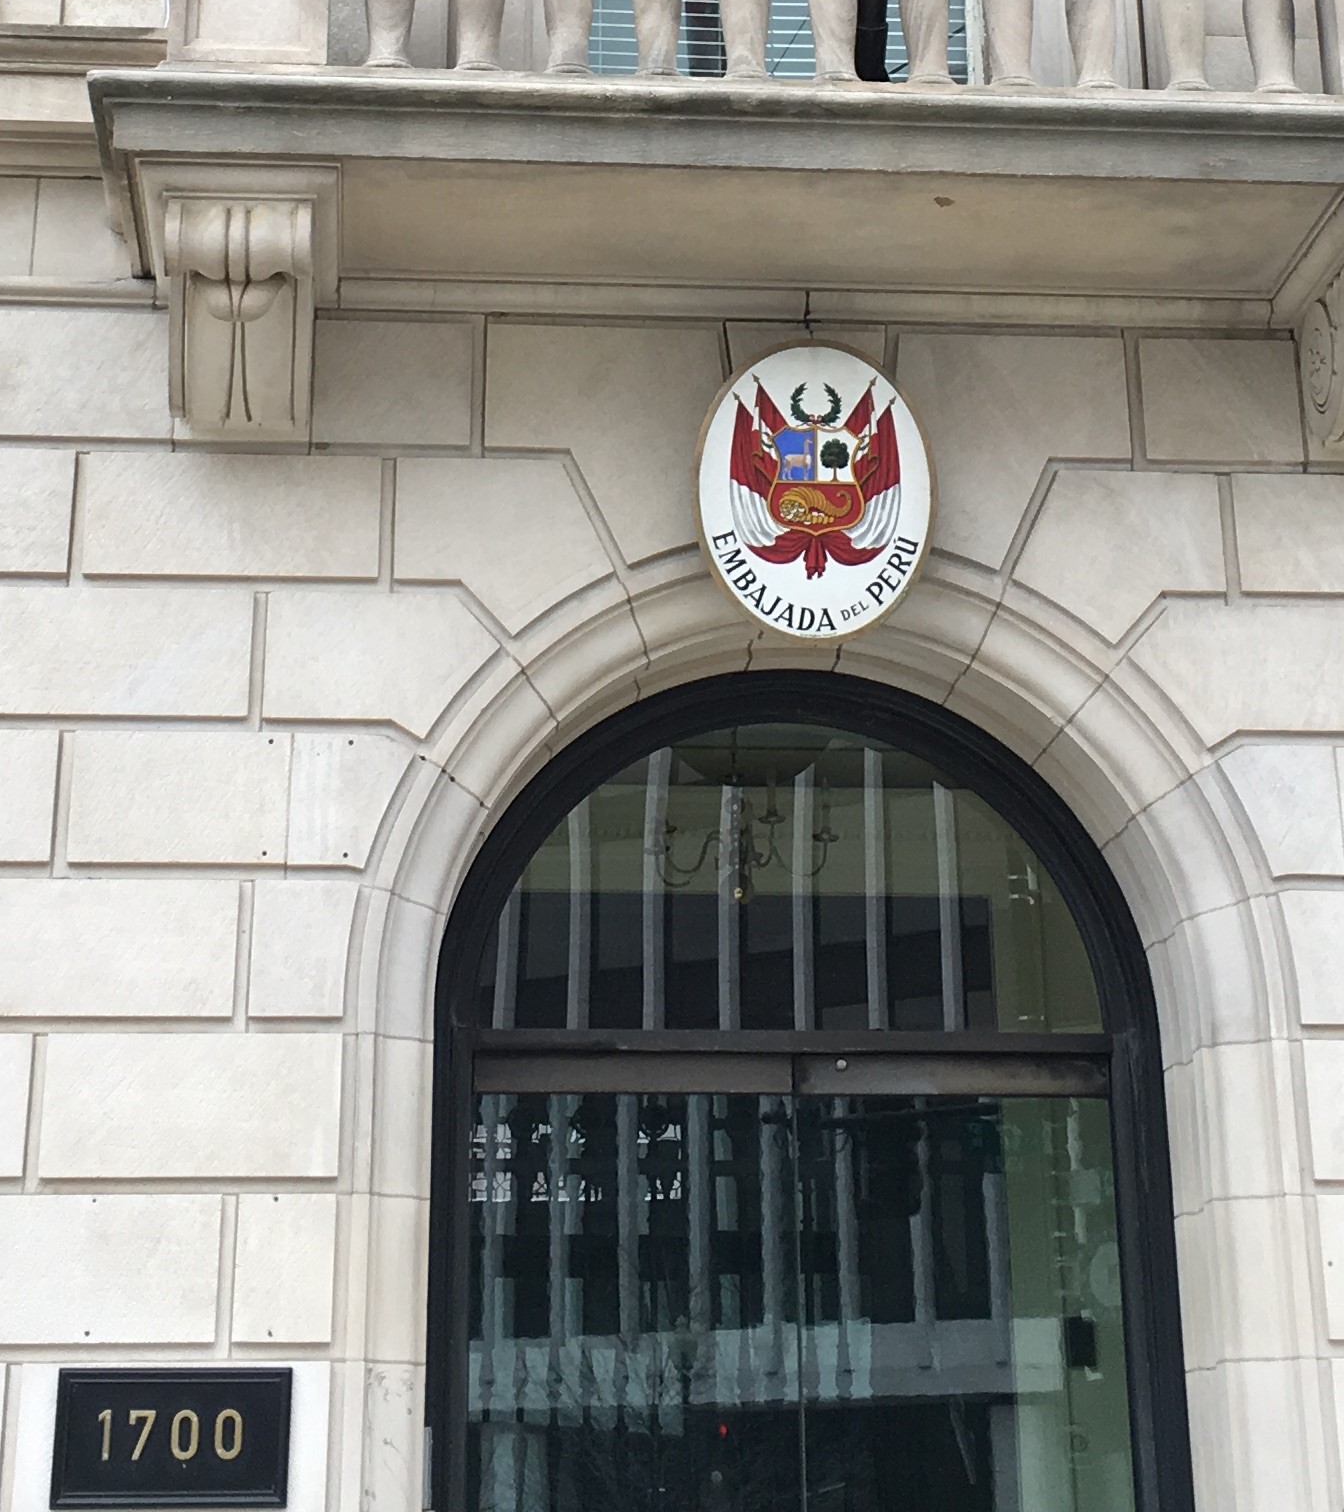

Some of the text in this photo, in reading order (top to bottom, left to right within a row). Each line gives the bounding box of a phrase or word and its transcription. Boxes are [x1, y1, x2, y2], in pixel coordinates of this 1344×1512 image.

[712, 529, 920, 632] EMBAJADA DEL PERÚ
[97, 1408, 243, 1462] 1700
